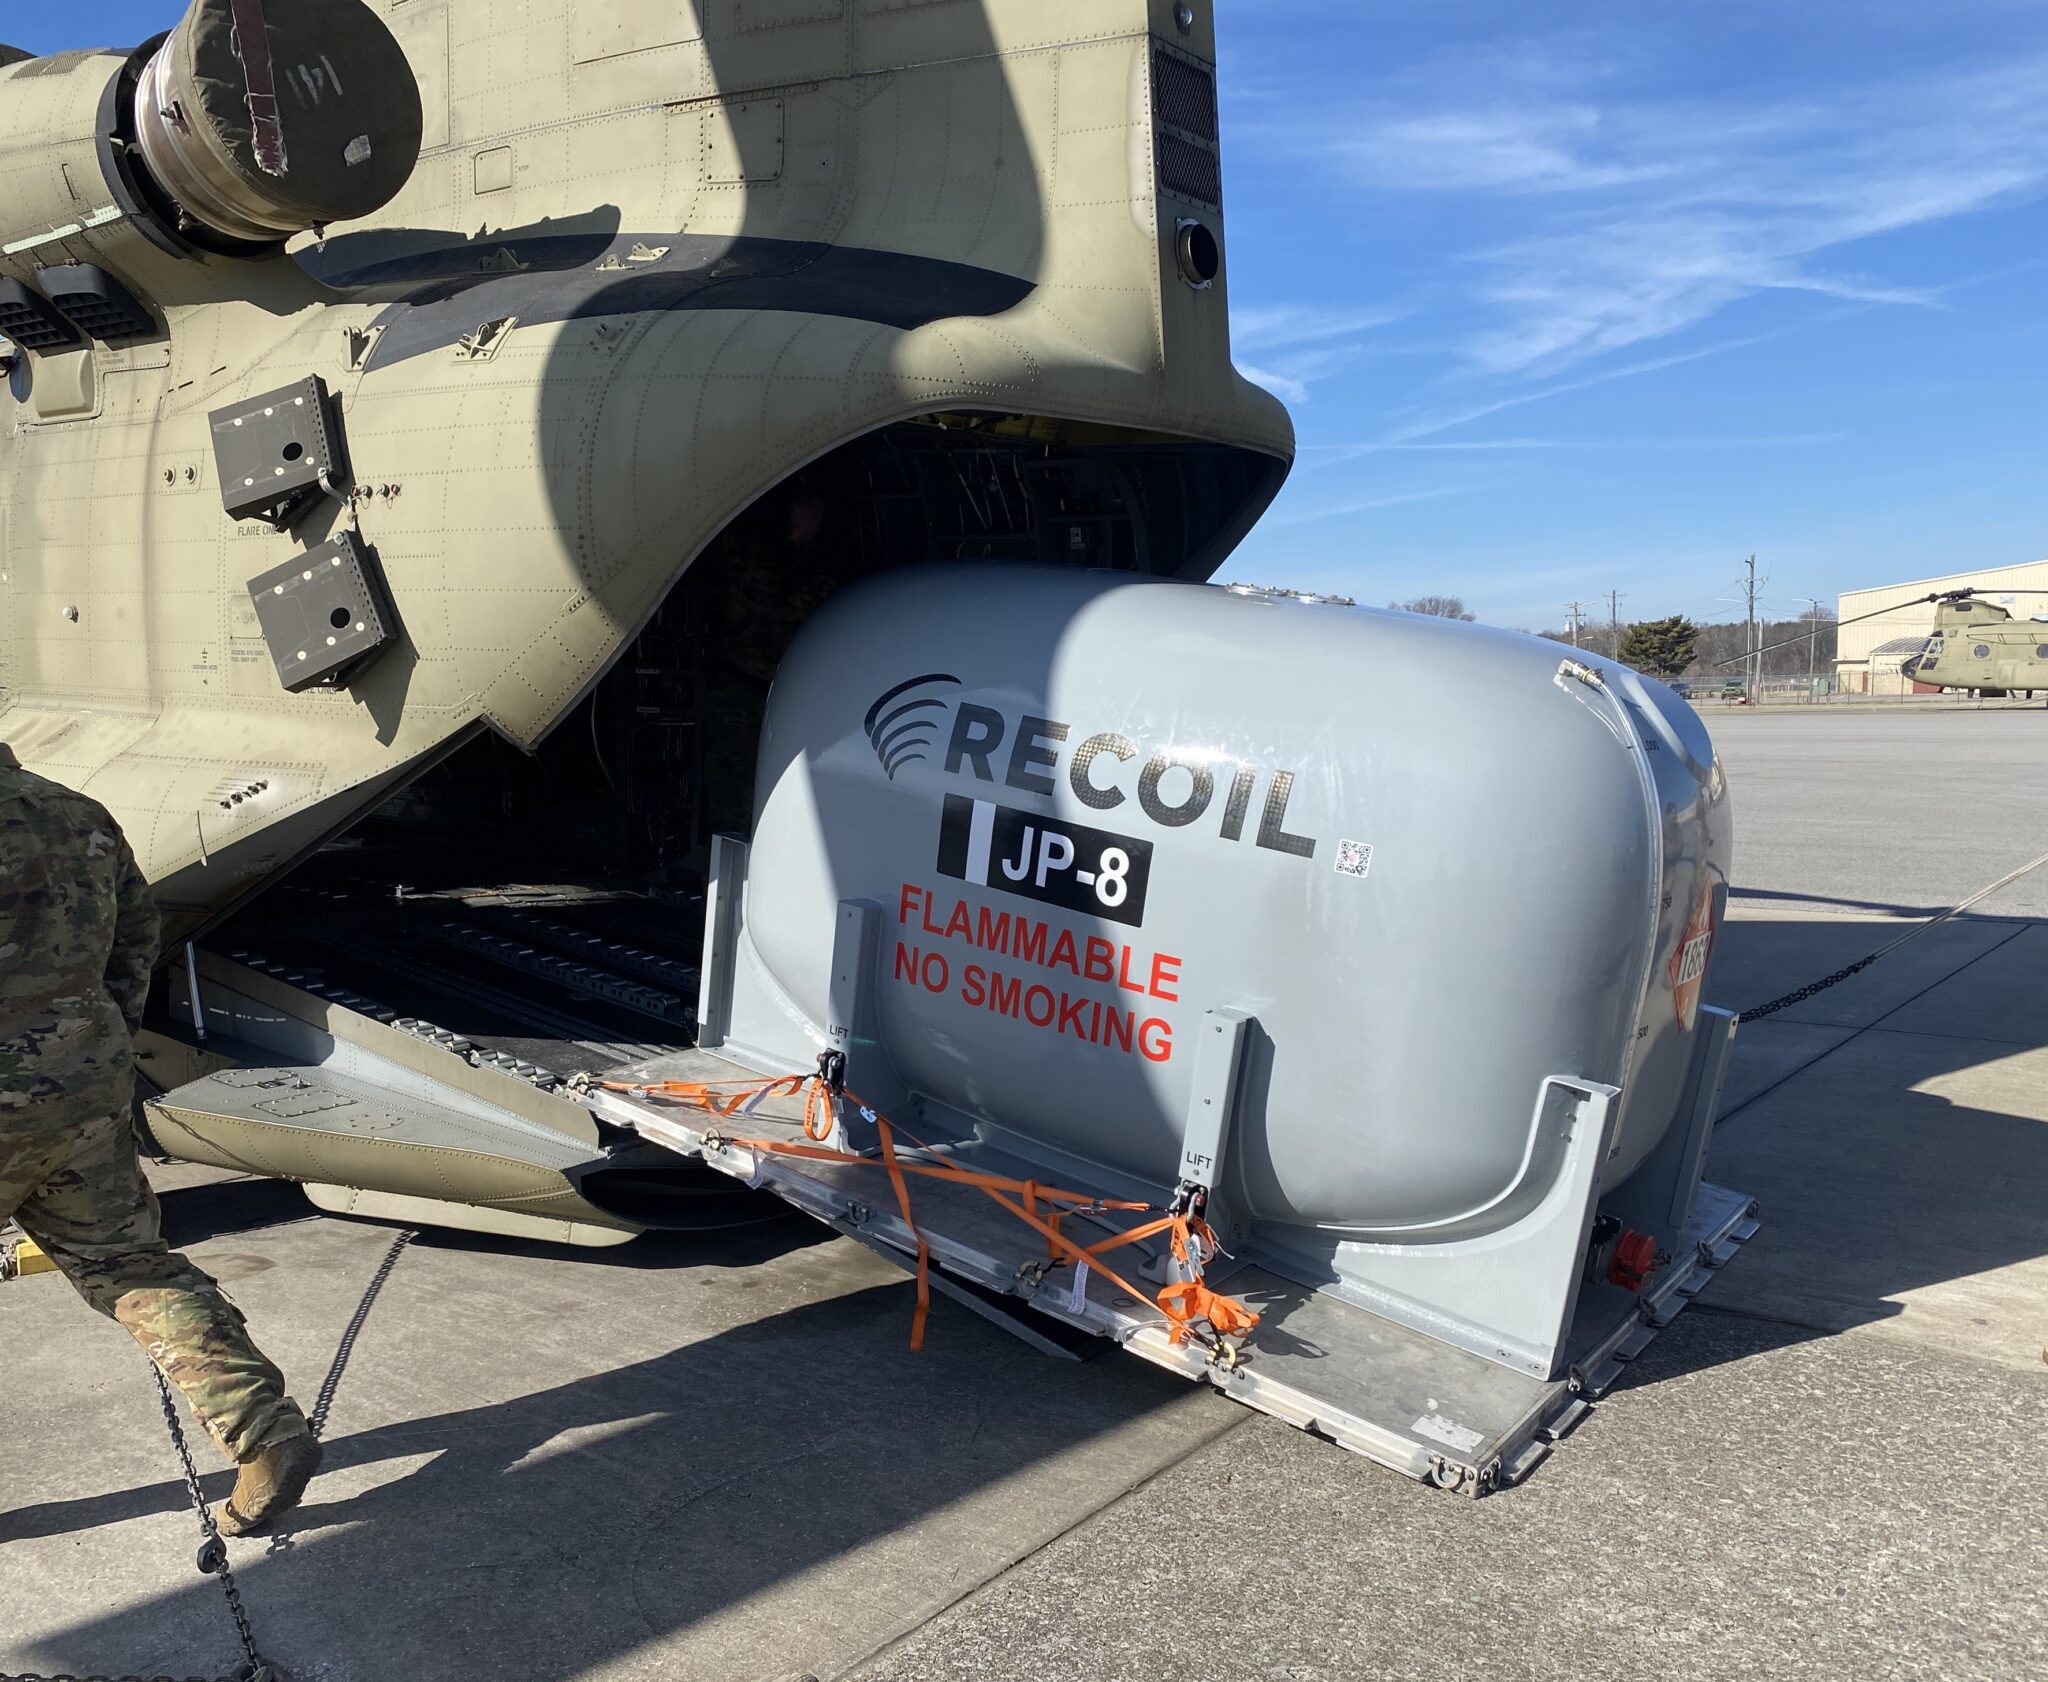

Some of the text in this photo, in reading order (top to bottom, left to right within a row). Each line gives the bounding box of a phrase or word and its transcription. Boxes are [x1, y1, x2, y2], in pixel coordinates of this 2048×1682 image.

[238, 526, 260, 537] FLARE
[944, 701, 1316, 860] RECOIL
[1002, 826, 1130, 907] JP-8
[899, 883, 1182, 1003] FLAMMABLE
[1681, 934, 1709, 982] 1863
[829, 1024, 849, 1039] LIFT
[894, 940, 1173, 1062] NO SMOKING
[1186, 1151, 1213, 1169] LIFT
